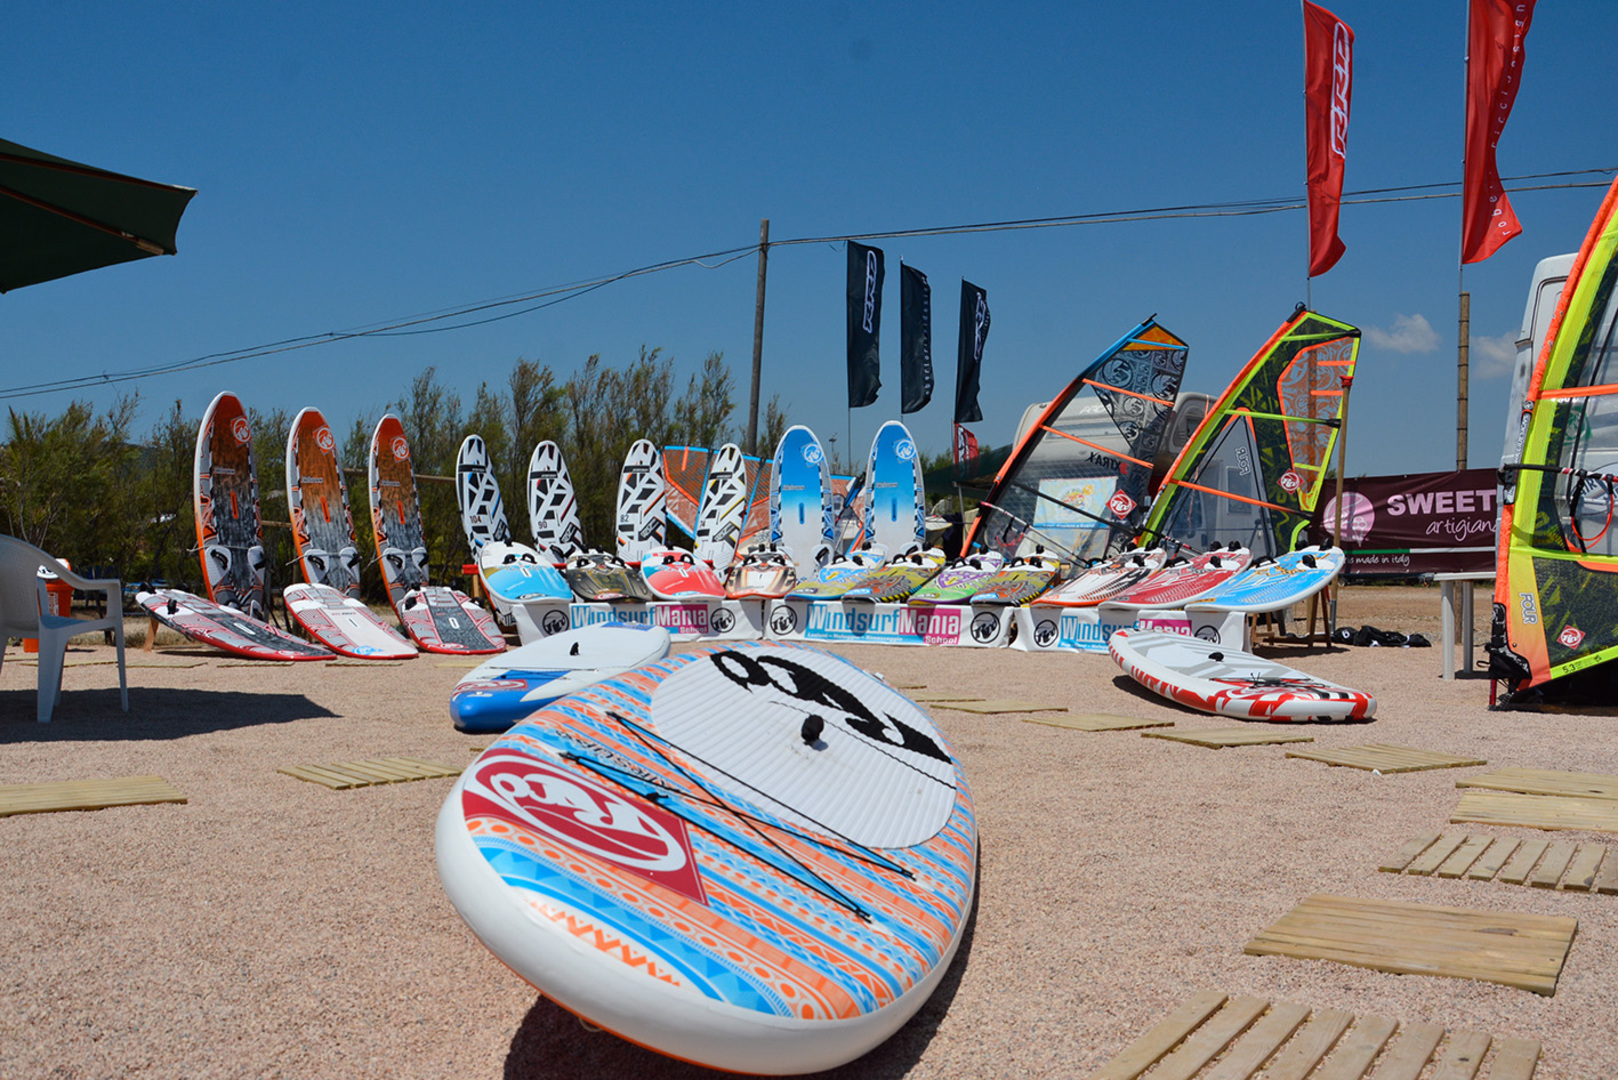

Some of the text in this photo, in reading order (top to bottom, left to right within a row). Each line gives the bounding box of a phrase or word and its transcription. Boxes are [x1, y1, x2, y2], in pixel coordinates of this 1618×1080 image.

[1386, 489, 1497, 517] SWEET
[1519, 592, 1538, 625] FOUR
[925, 635, 958, 644] School
